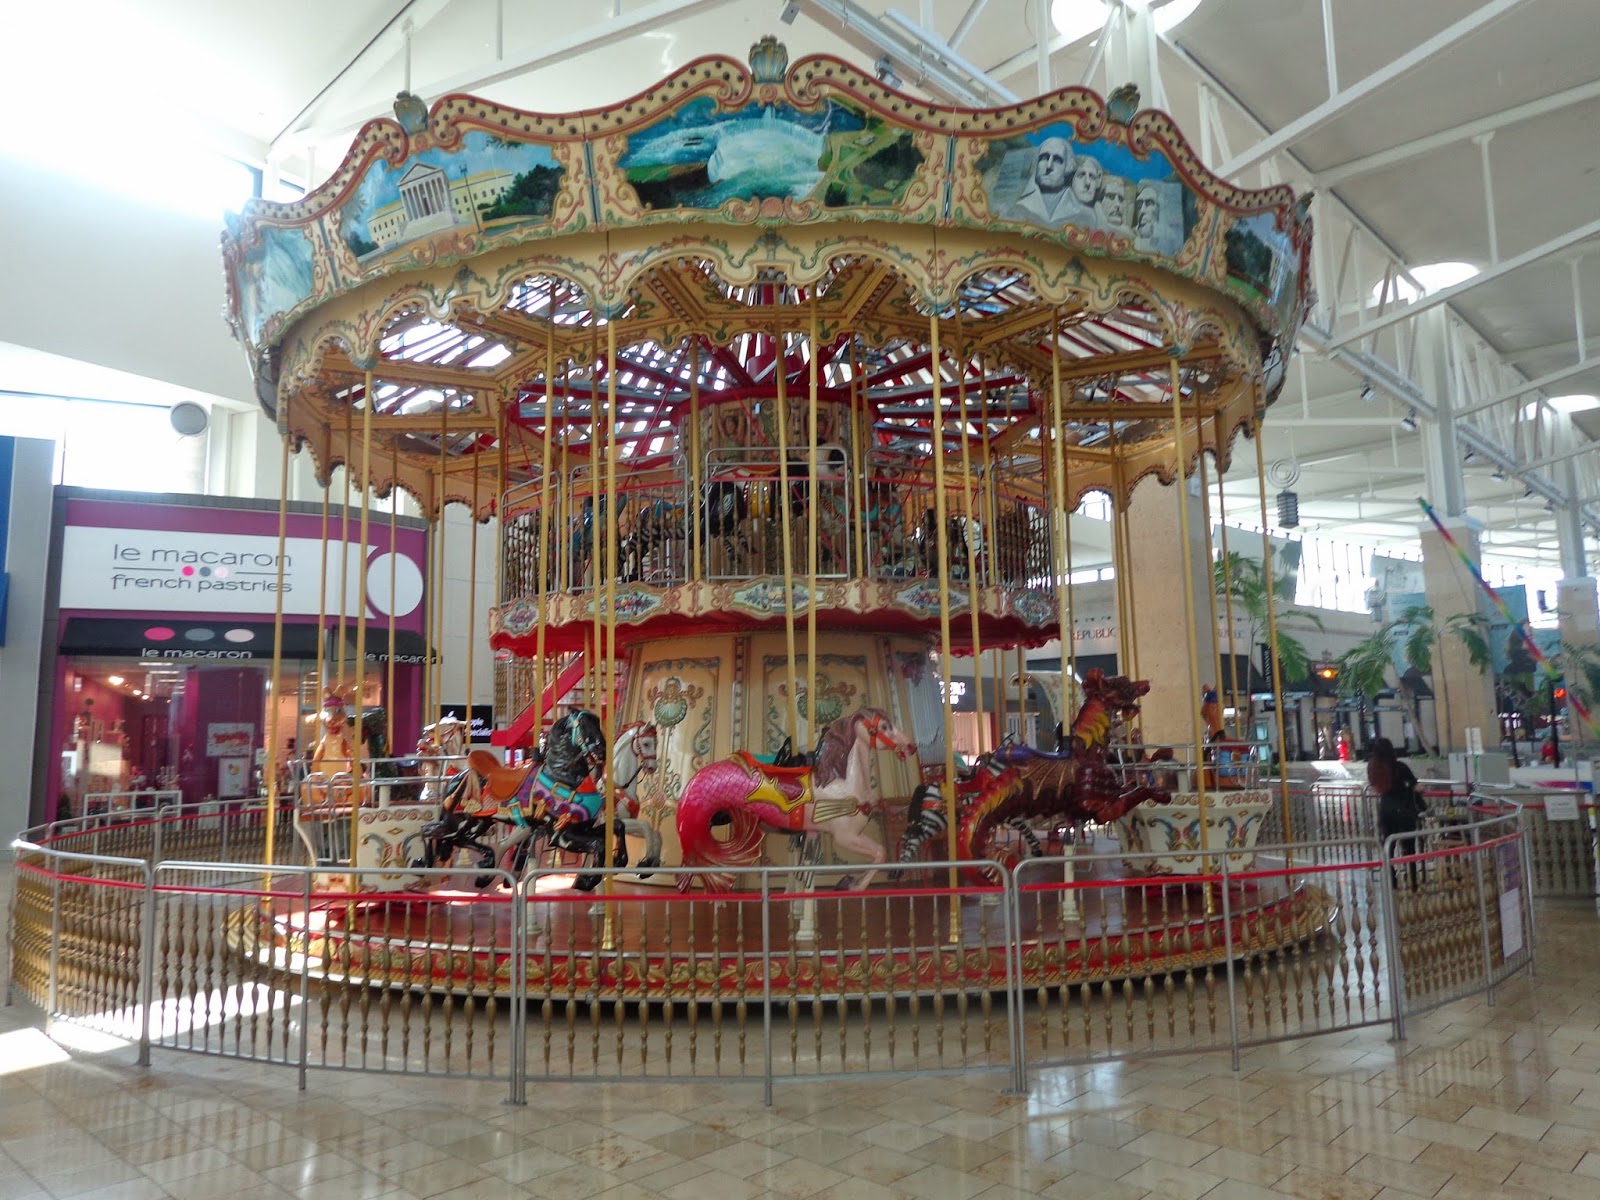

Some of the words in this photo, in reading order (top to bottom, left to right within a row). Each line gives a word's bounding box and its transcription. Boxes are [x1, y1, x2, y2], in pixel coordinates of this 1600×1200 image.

[113, 543, 141, 561] le
[151, 549, 292, 568] macaron
[111, 574, 191, 590] french
[198, 579, 292, 593] pastries
[141, 647, 160, 658] le
[164, 649, 253, 660] macaron
[364, 652, 377, 661] le
